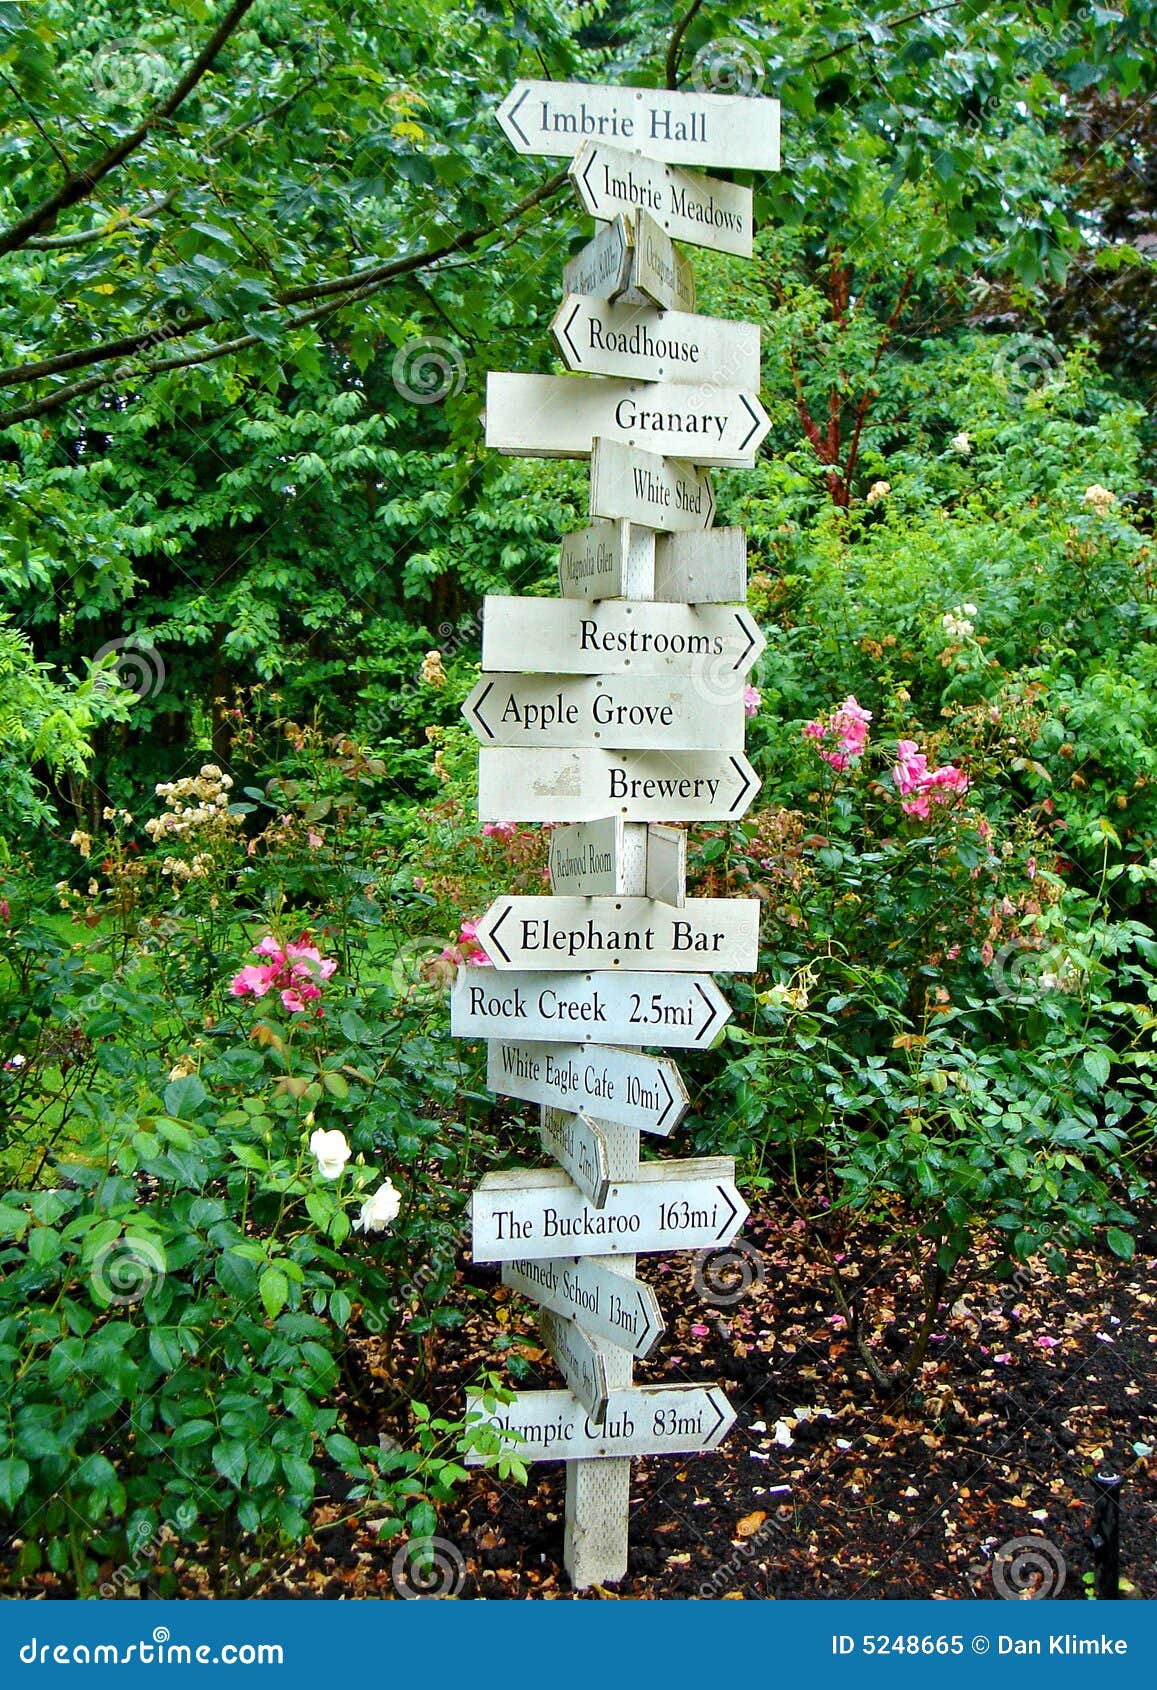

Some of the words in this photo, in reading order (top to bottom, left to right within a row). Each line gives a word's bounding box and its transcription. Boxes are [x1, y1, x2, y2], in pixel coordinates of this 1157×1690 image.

[539, 101, 634, 137] Imbrie
[649, 109, 708, 143] Hall
[602, 164, 662, 210] Imbrie
[670, 185, 743, 233] Meadows
[587, 316, 700, 364] Roadhouse
[615, 398, 729, 441] Granary
[632, 467, 671, 507] White
[675, 480, 702, 515] Shed
[565, 549, 595, 583] Magnolia
[596, 543, 614, 576] Glen
[579, 619, 724, 656] Restrooms
[500, 693, 579, 730] Apple
[592, 693, 674, 726] Grove
[607, 767, 720, 804] Brewery
[556, 846, 587, 879] Redwood
[588, 844, 612, 874] Room
[519, 919, 655, 956] Elephant
[671, 920, 725, 952] Bar
[468, 986, 528, 1018] Rock
[538, 989, 607, 1022] Creek
[628, 993, 694, 1026] 2.5mi
[501, 1045, 540, 1082] White
[544, 1055, 579, 1095] Eagle
[584, 1064, 615, 1100] Cafe
[625, 1075, 660, 1112] 10mi
[492, 1211, 533, 1240] The
[542, 1206, 641, 1237] Buckaroo
[658, 1201, 718, 1231] 163mi
[511, 1258, 559, 1298] Kennedy
[562, 1269, 600, 1315] School
[608, 1294, 638, 1335] 13mi
[584, 1410, 635, 1440] Club
[652, 1408, 703, 1436] 83mi
